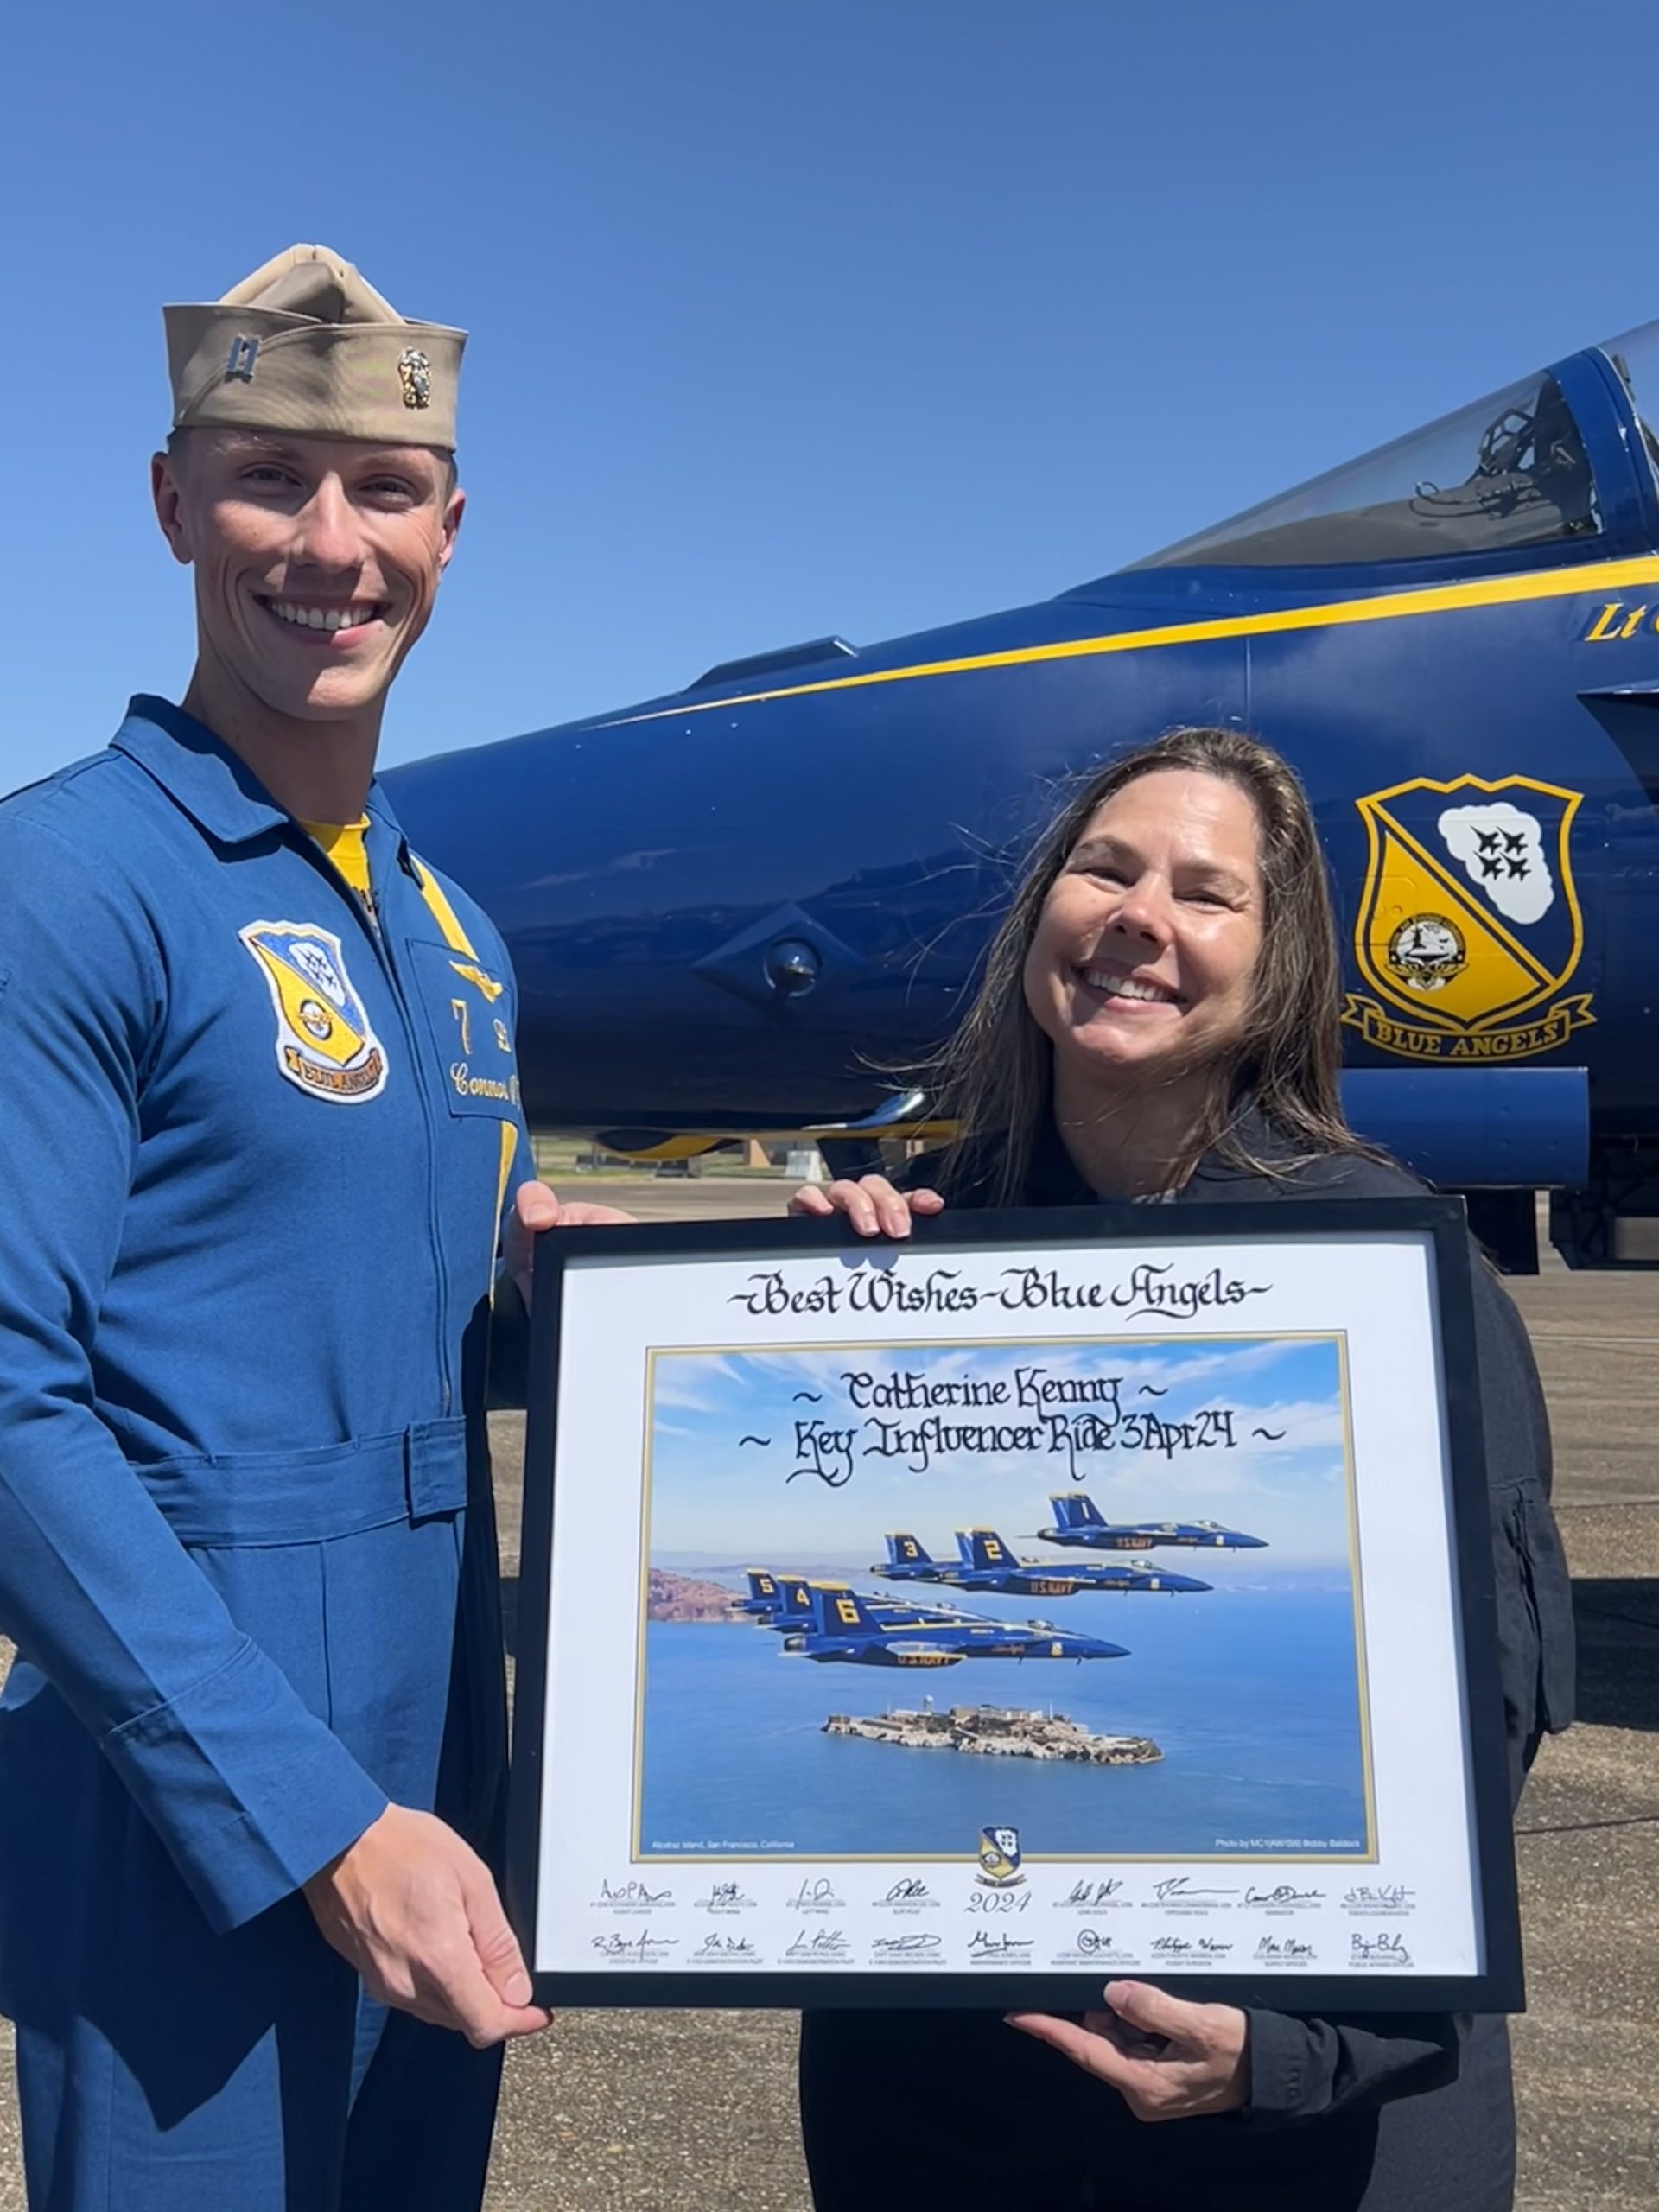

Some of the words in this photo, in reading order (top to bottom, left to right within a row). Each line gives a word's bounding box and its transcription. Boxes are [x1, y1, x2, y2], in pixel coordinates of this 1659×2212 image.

[1583, 602, 1647, 642] Lt
[450, 998, 472, 1055] 7
[1376, 1018, 1441, 1055] BLUE
[1450, 1022, 1559, 1056] ANGELS
[746, 1269, 844, 1315] Best
[847, 1268, 978, 1313] Wishes
[999, 1265, 1107, 1309] Blue
[1110, 1262, 1248, 1322] Angels
[840, 1371, 1012, 1409] Catherine
[1014, 1366, 1123, 1427] Kenny
[785, 1420, 859, 1487] Key
[862, 1415, 1045, 1472] Influencer
[1046, 1414, 1116, 1481] Ride
[904, 1541, 918, 1558] 3
[983, 1540, 1003, 1560] 2
[760, 1577, 775, 1594] 5
[796, 1587, 810, 1607] 4
[835, 1599, 861, 1624] 6
[963, 1891, 1033, 1913] 2024
